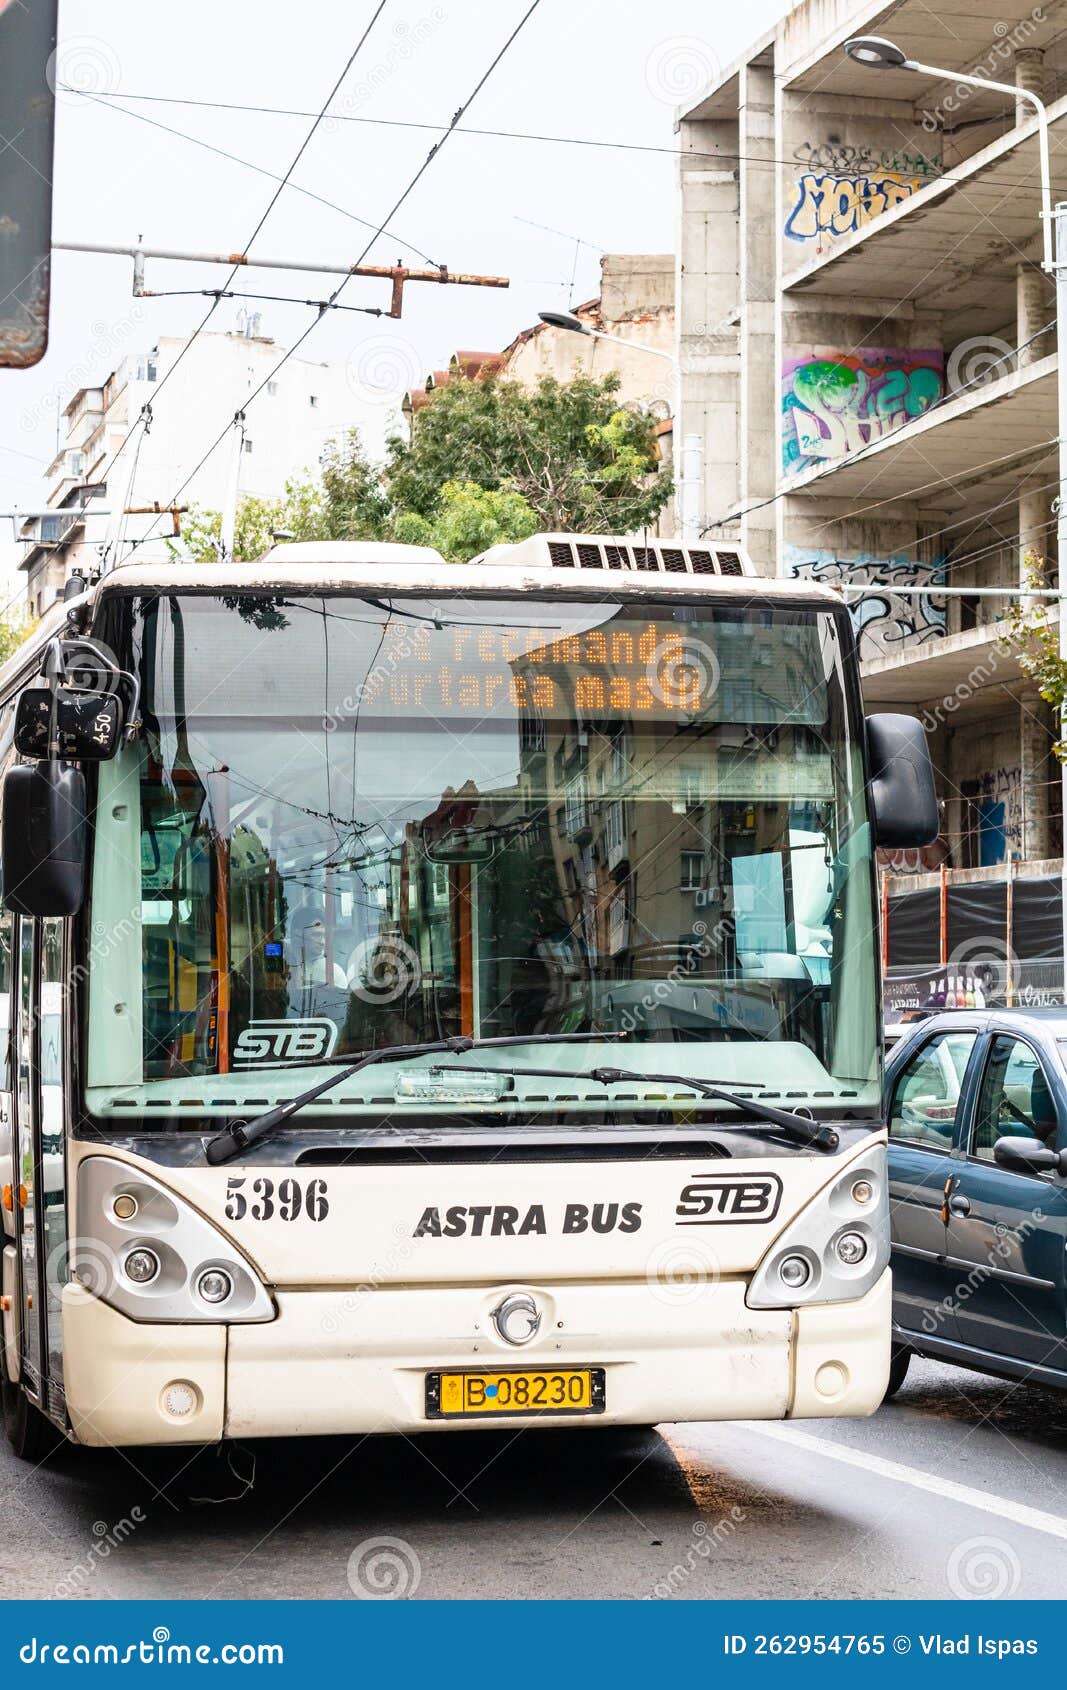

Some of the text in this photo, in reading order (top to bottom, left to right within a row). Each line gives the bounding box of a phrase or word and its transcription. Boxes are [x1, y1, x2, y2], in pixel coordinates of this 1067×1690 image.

[454, 624, 683, 663] recomanda
[93, 714, 111, 744] 450
[234, 1026, 327, 1058] STB
[225, 1177, 329, 1222] 5396
[675, 1182, 773, 1216] STB
[413, 1202, 643, 1237] ASTRA BUS
